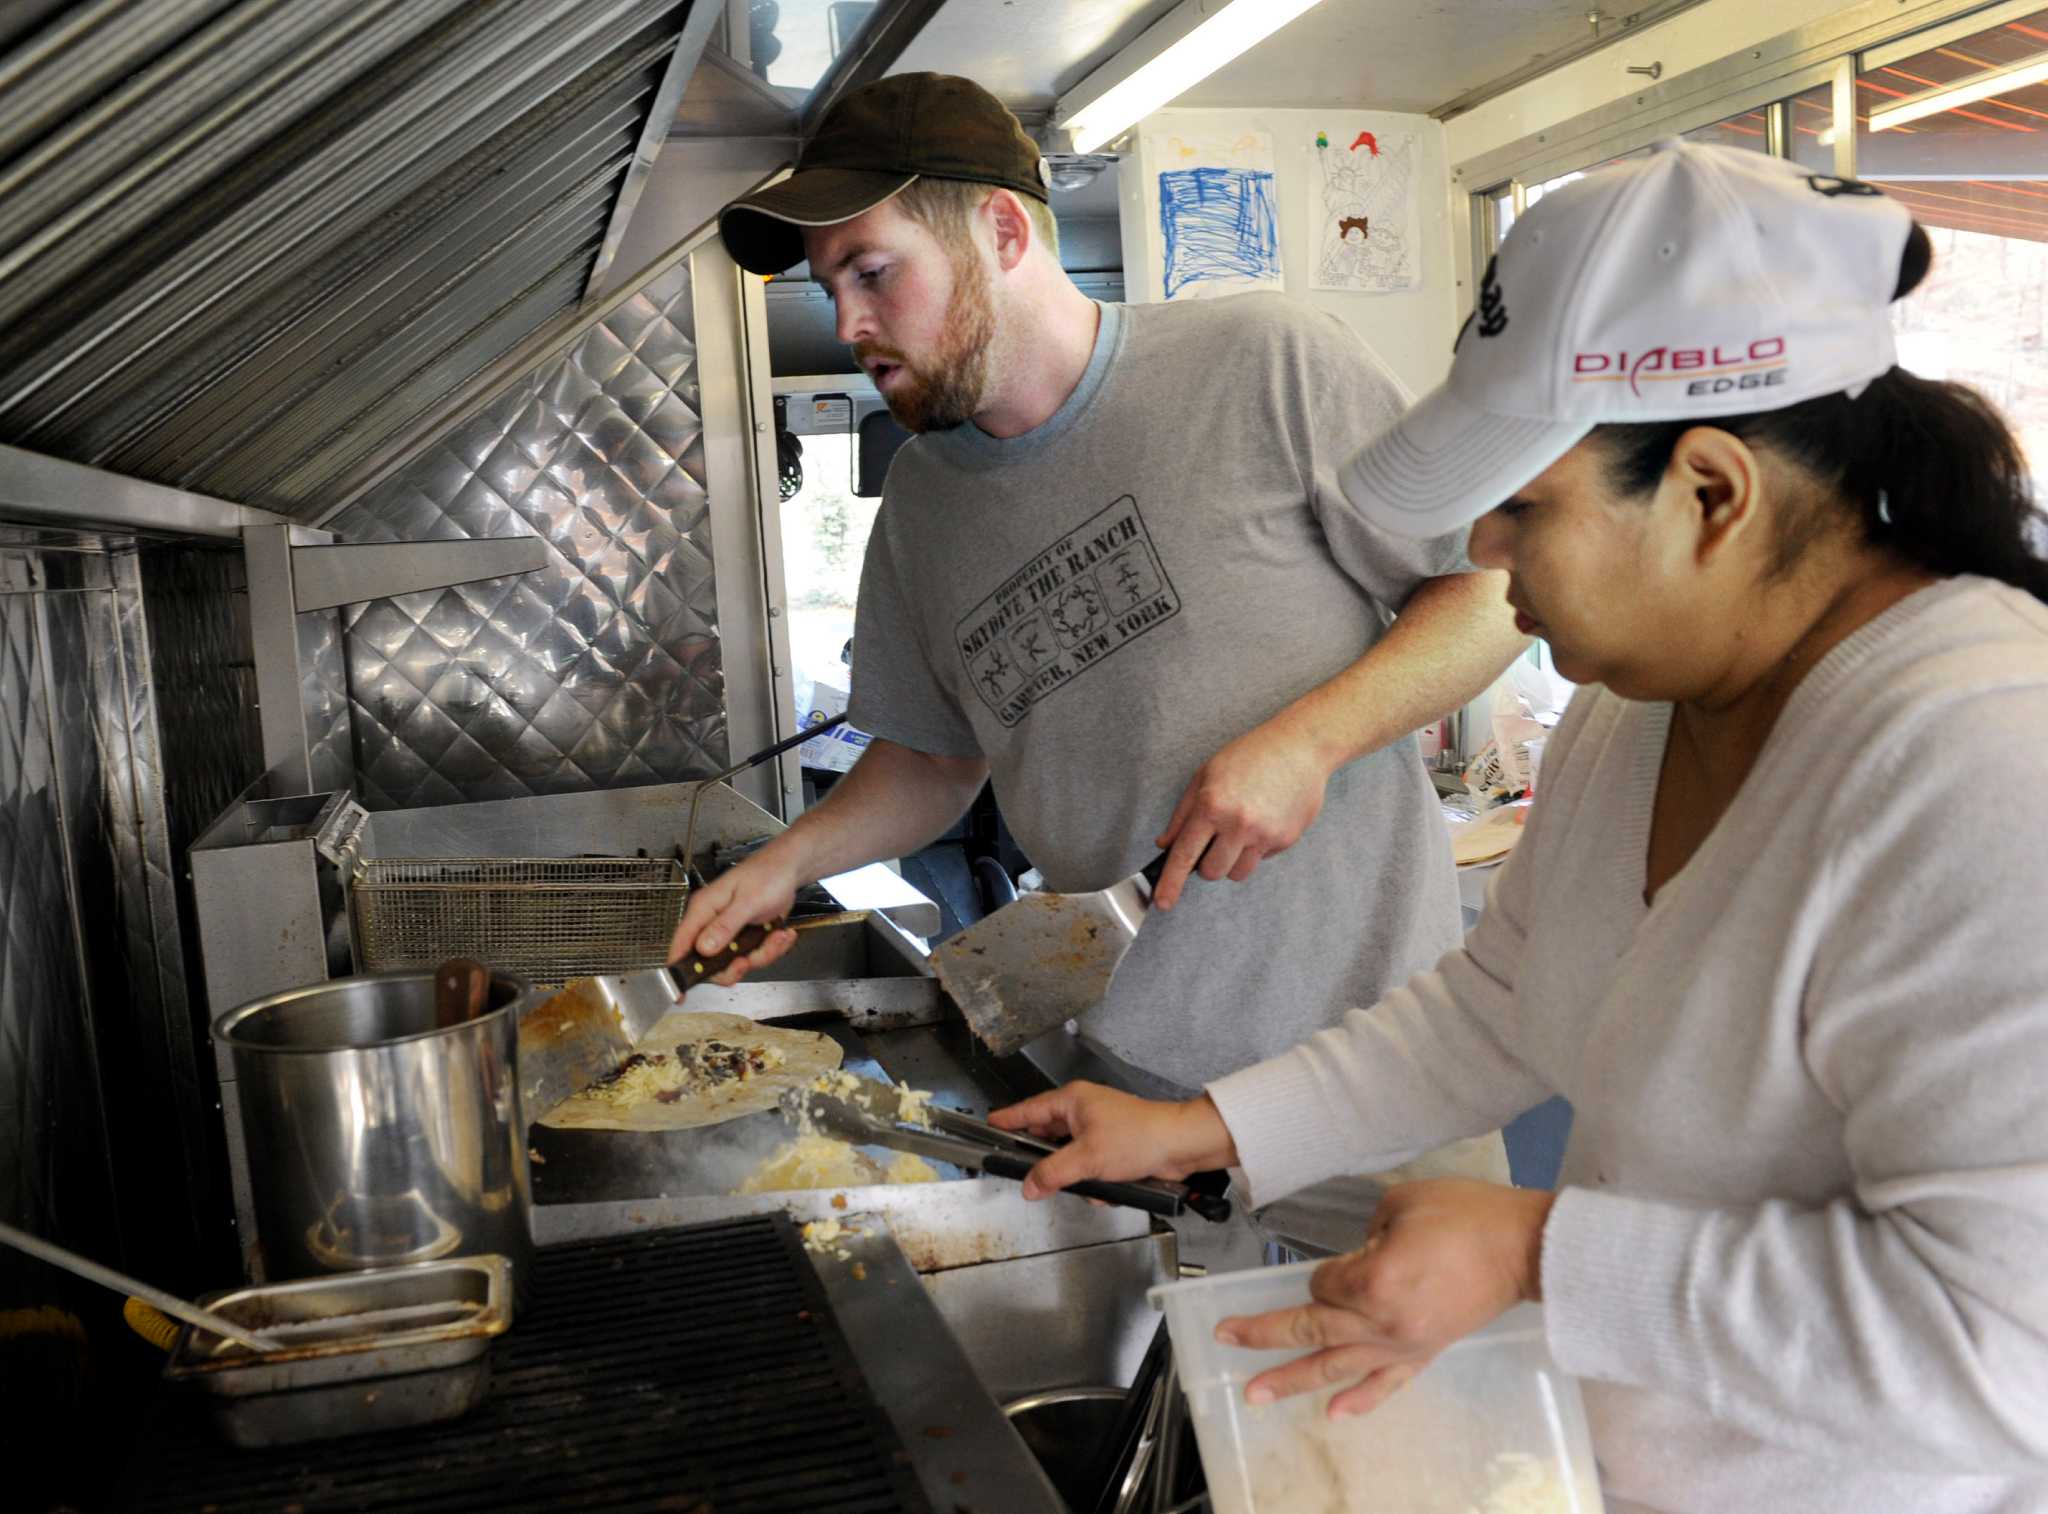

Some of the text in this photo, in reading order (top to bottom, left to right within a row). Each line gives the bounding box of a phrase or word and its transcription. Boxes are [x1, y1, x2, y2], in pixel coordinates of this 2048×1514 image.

[1575, 336, 1785, 398] DIABLO
[1687, 368, 1788, 396] EDGE
[1056, 538, 1074, 557] OF
[962, 516, 1138, 659] SKYDIVE THE RANCH
[1071, 631, 1110, 667] NEW
[1115, 595, 1172, 637] YORK
